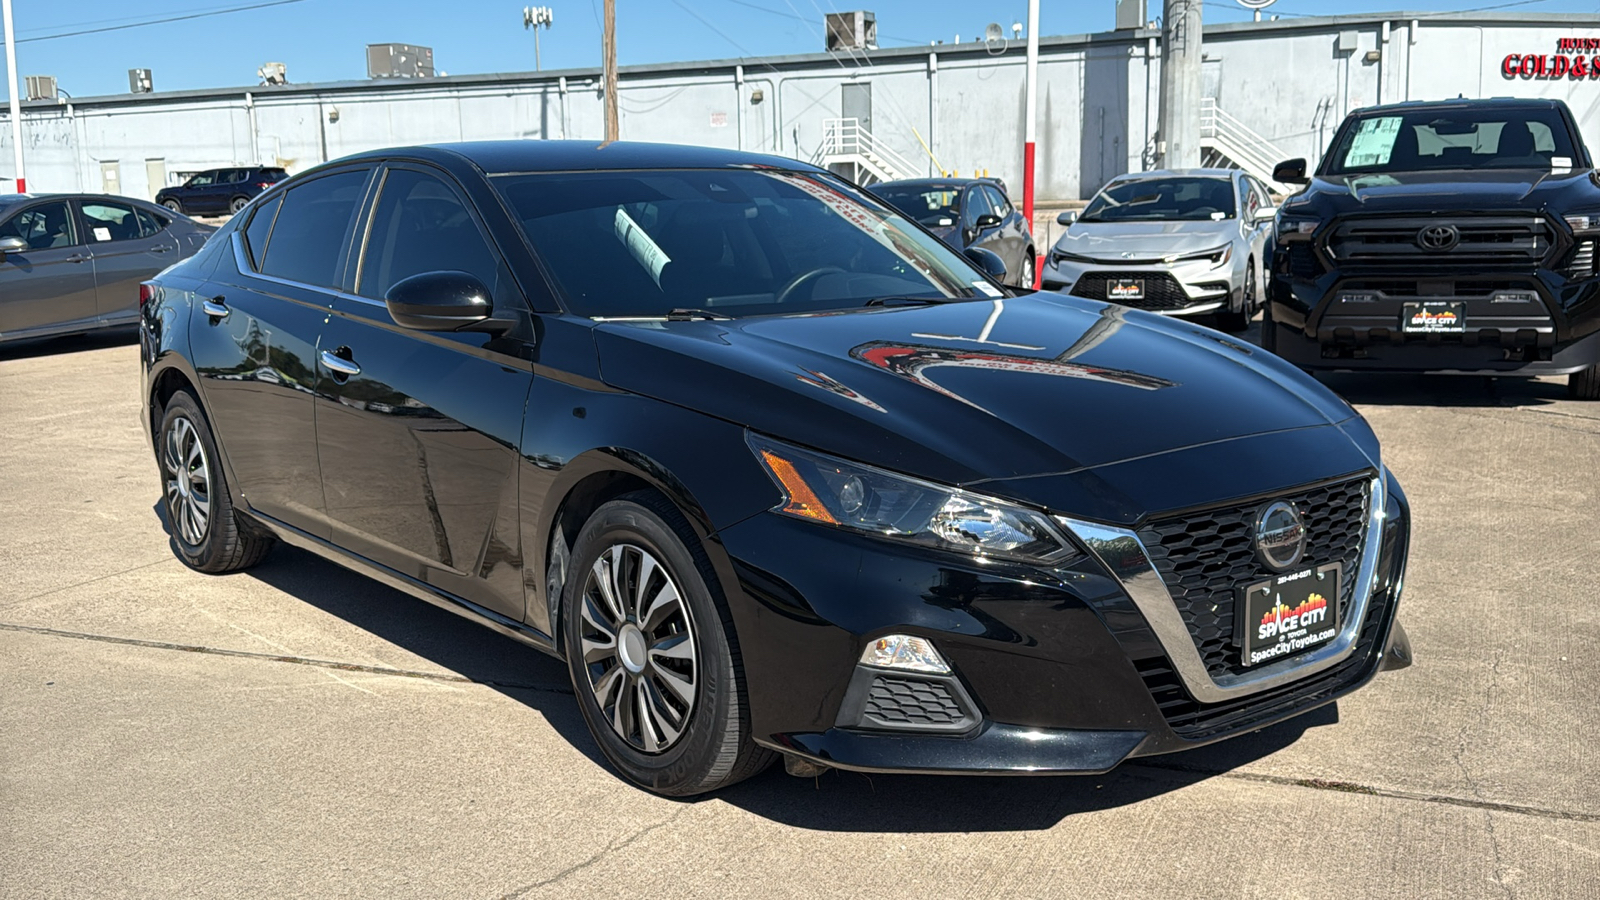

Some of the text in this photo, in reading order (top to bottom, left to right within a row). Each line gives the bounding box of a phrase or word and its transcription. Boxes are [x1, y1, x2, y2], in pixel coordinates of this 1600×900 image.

[1438, 317, 1457, 325] CITY
[1264, 525, 1302, 545] NISSAN
[1258, 604, 1327, 639] SPACE CITY
[1287, 628, 1308, 639] TOYOTA
[1251, 628, 1335, 663] SpaceCityToyota.com
